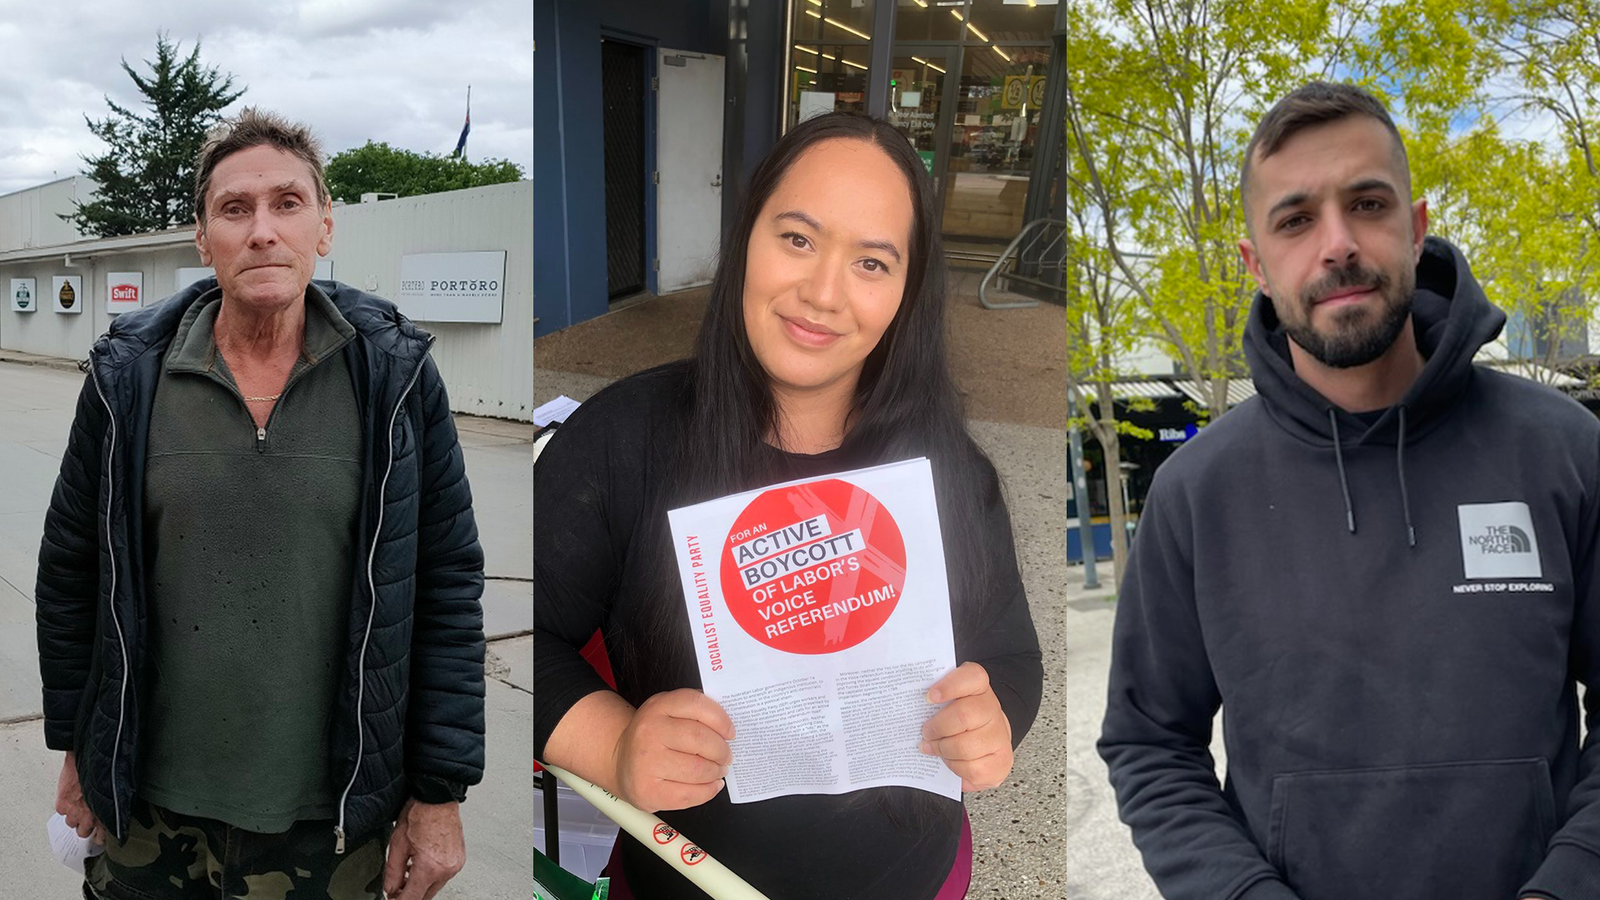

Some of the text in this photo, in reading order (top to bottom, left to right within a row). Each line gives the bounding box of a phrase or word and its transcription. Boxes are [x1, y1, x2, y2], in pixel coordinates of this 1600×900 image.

[923, 121, 936, 129] Only
[113, 287, 136, 299] Swift
[1159, 428, 1186, 441] Ribs
[729, 522, 768, 544] FOR AN
[1485, 525, 1509, 534] THE
[738, 518, 822, 565] ACTIVE
[1469, 534, 1510, 545] NORTH
[1481, 544, 1511, 554] FACE
[744, 532, 855, 586] BOYCOTT
[752, 583, 778, 604] OF
[1453, 582, 1554, 593] NEVER STOP EXPLORING
[686, 535, 723, 672] SOCIALIST EQUALITY PARTY
[758, 590, 817, 621] VOICE
[764, 583, 896, 640] REFERENDUM!
